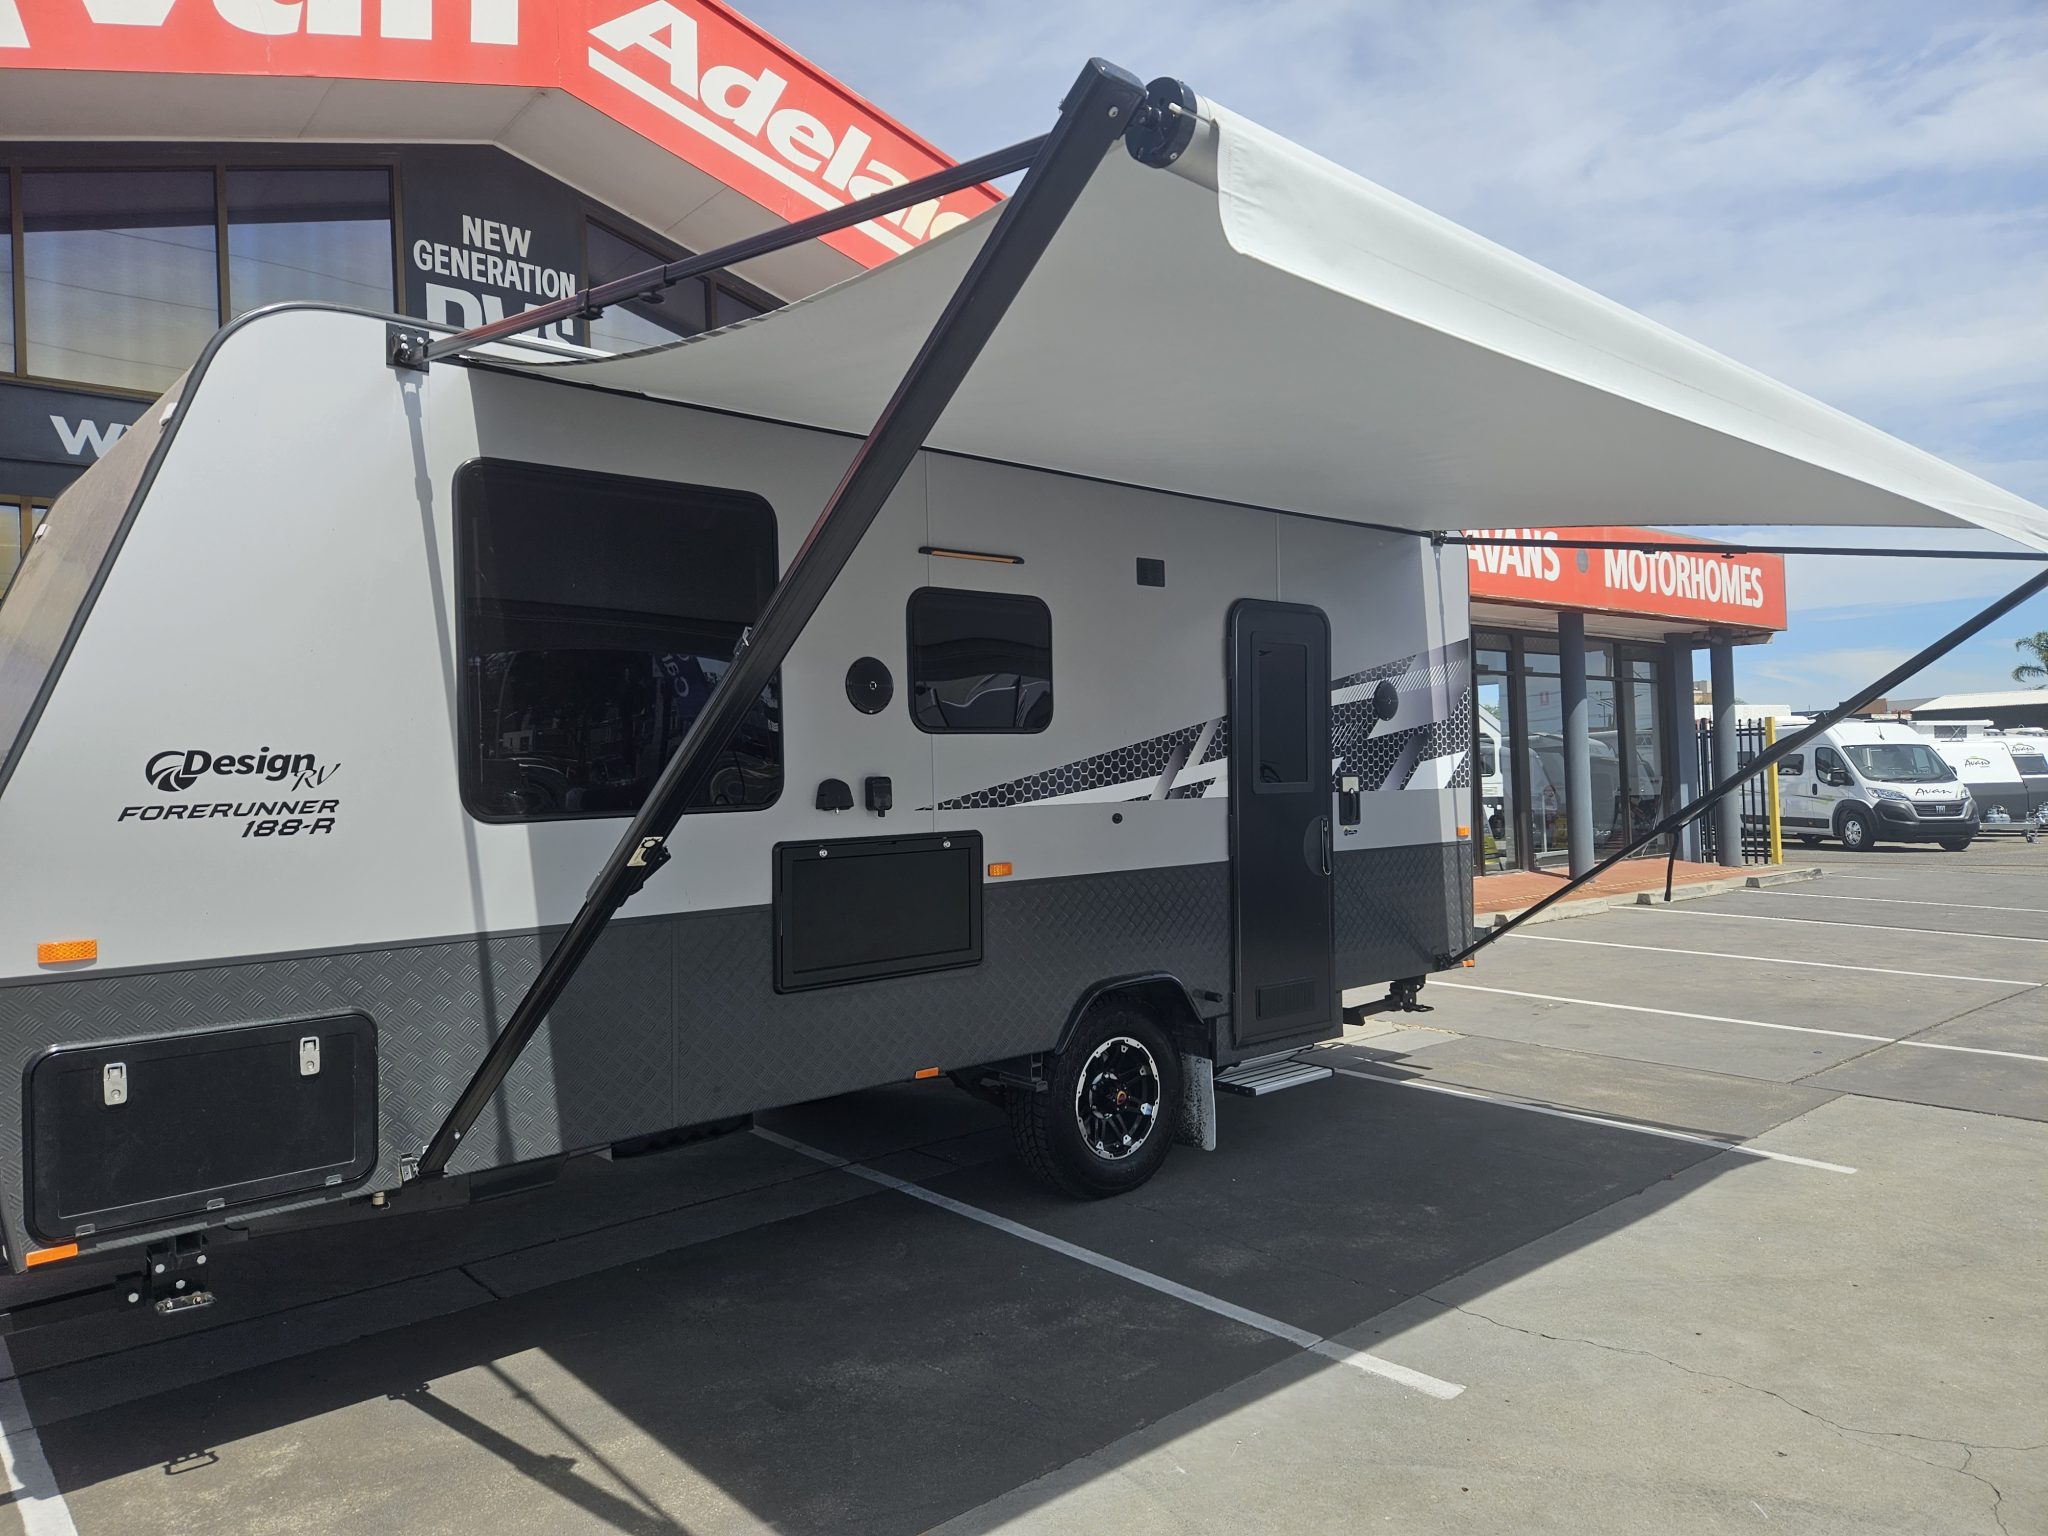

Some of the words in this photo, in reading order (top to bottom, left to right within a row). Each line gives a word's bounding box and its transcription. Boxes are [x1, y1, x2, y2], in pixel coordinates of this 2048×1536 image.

[462, 214, 532, 258] NEW
[412, 239, 577, 300] GENERATION
[1603, 549, 1764, 609] MOTORHOMES
[181, 746, 316, 782] Design
[290, 762, 342, 792] RV
[117, 799, 341, 822] FORERUNNER
[1915, 787, 1953, 797] Avan
[241, 817, 337, 838] 188-R
